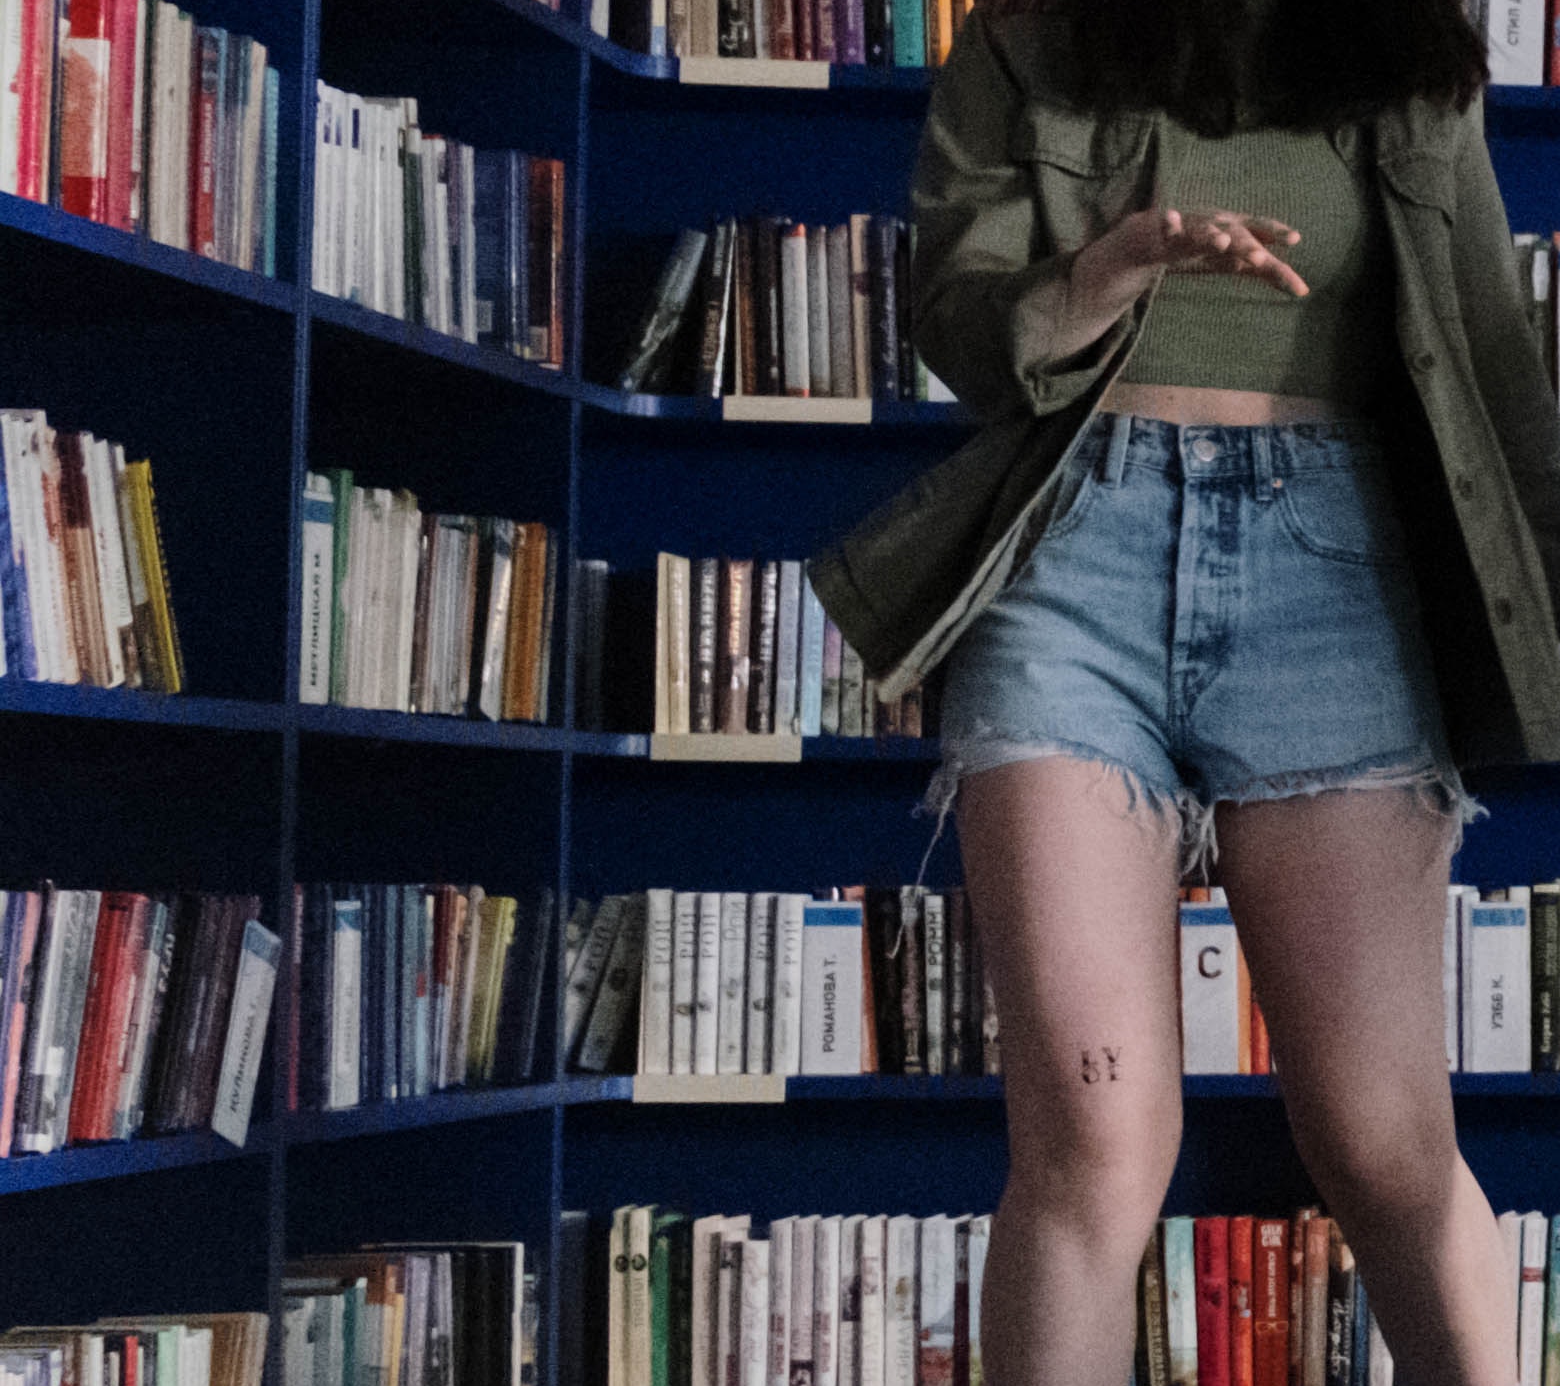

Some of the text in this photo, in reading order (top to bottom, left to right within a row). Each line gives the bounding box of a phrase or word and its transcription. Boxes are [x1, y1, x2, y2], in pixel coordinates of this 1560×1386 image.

[1507, 7, 1521, 47] СТИЛ
[1197, 945, 1223, 979] С
[821, 971, 837, 1054] РОМАНОВА
[1490, 993, 1505, 1031] УЭББ
